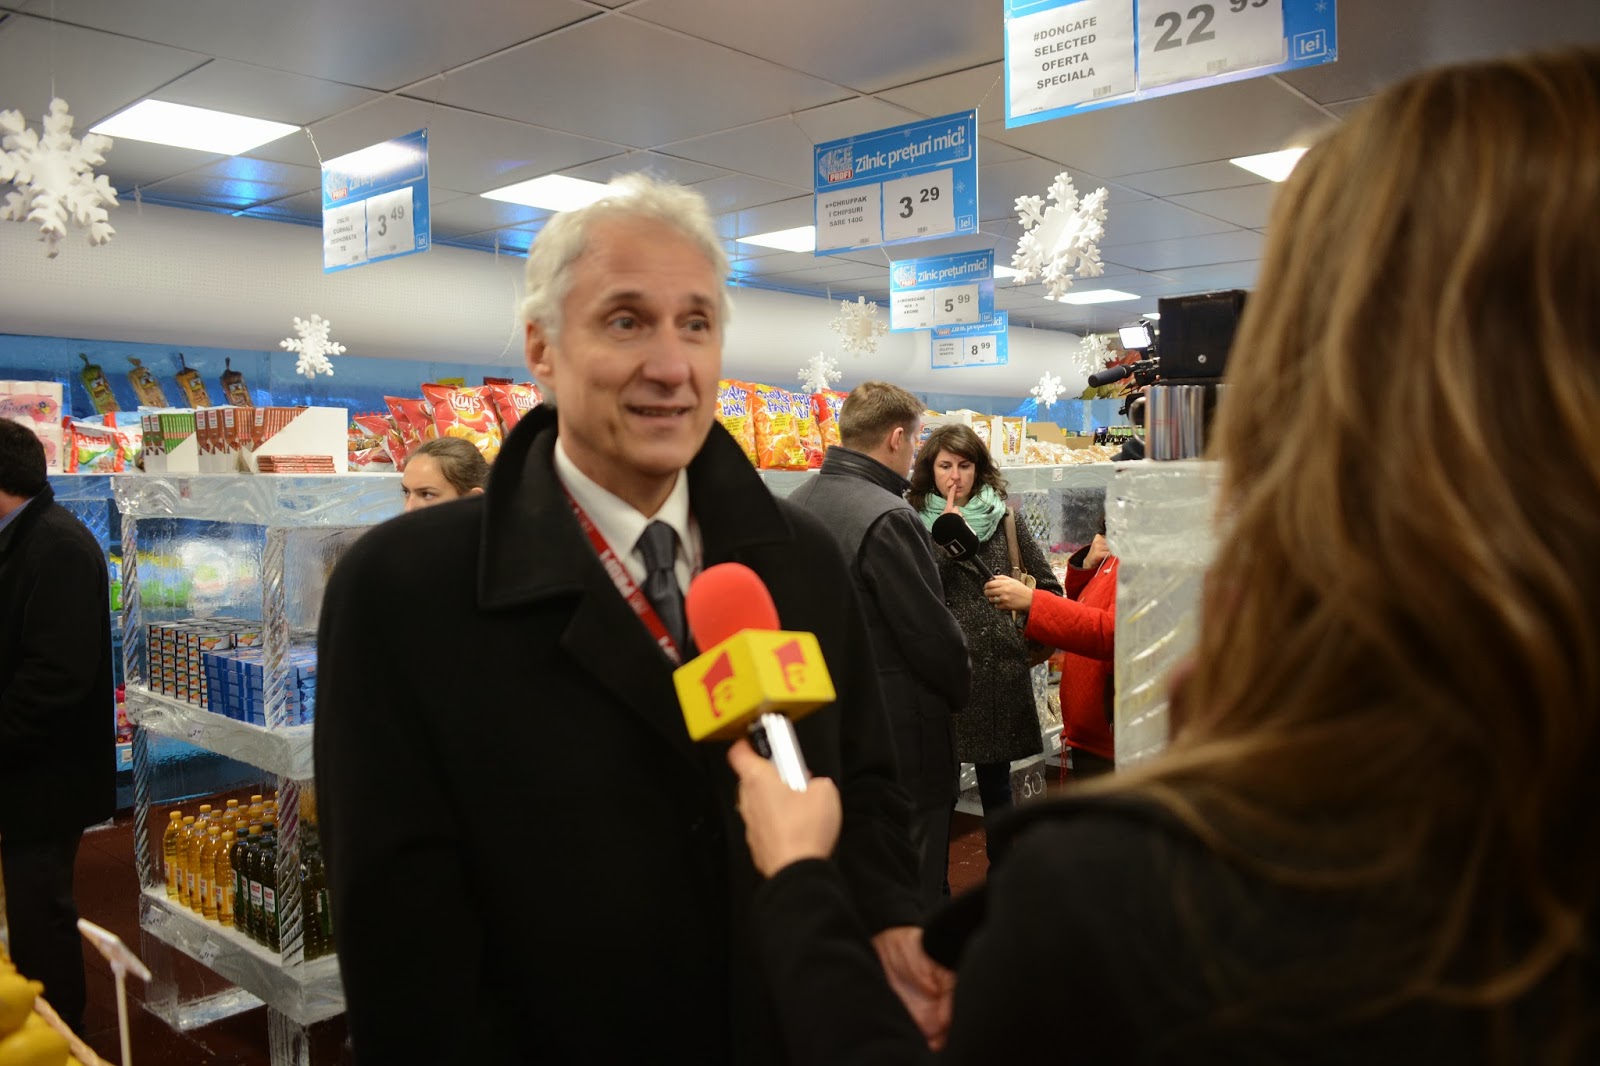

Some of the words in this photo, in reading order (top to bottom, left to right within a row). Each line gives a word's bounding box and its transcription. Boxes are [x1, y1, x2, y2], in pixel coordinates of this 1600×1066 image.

[1033, 17, 1097, 42] #DONCAFE
[1153, 4, 1216, 52] 22
[1034, 34, 1096, 57] SELECTED
[1300, 34, 1320, 54] lei
[1042, 52, 1089, 72] OFERTA
[1037, 67, 1095, 89] SPECIALA
[855, 154, 887, 174] Zilnic
[933, 126, 965, 150] mici!
[829, 170, 852, 182] PROFI
[833, 206, 863, 217] CHIPSURI
[899, 196, 913, 219] 3
[919, 186, 940, 203] 29
[377, 214, 387, 237] 3
[390, 205, 404, 221] 49
[829, 219, 846, 227] SARE
[848, 216, 863, 225] 140G
[960, 217, 970, 228] lei
[918, 268, 938, 282] Zilnic
[967, 257, 987, 272] mici!
[944, 299, 954, 313] 5
[957, 294, 971, 304] 99
[971, 345, 978, 355] 8
